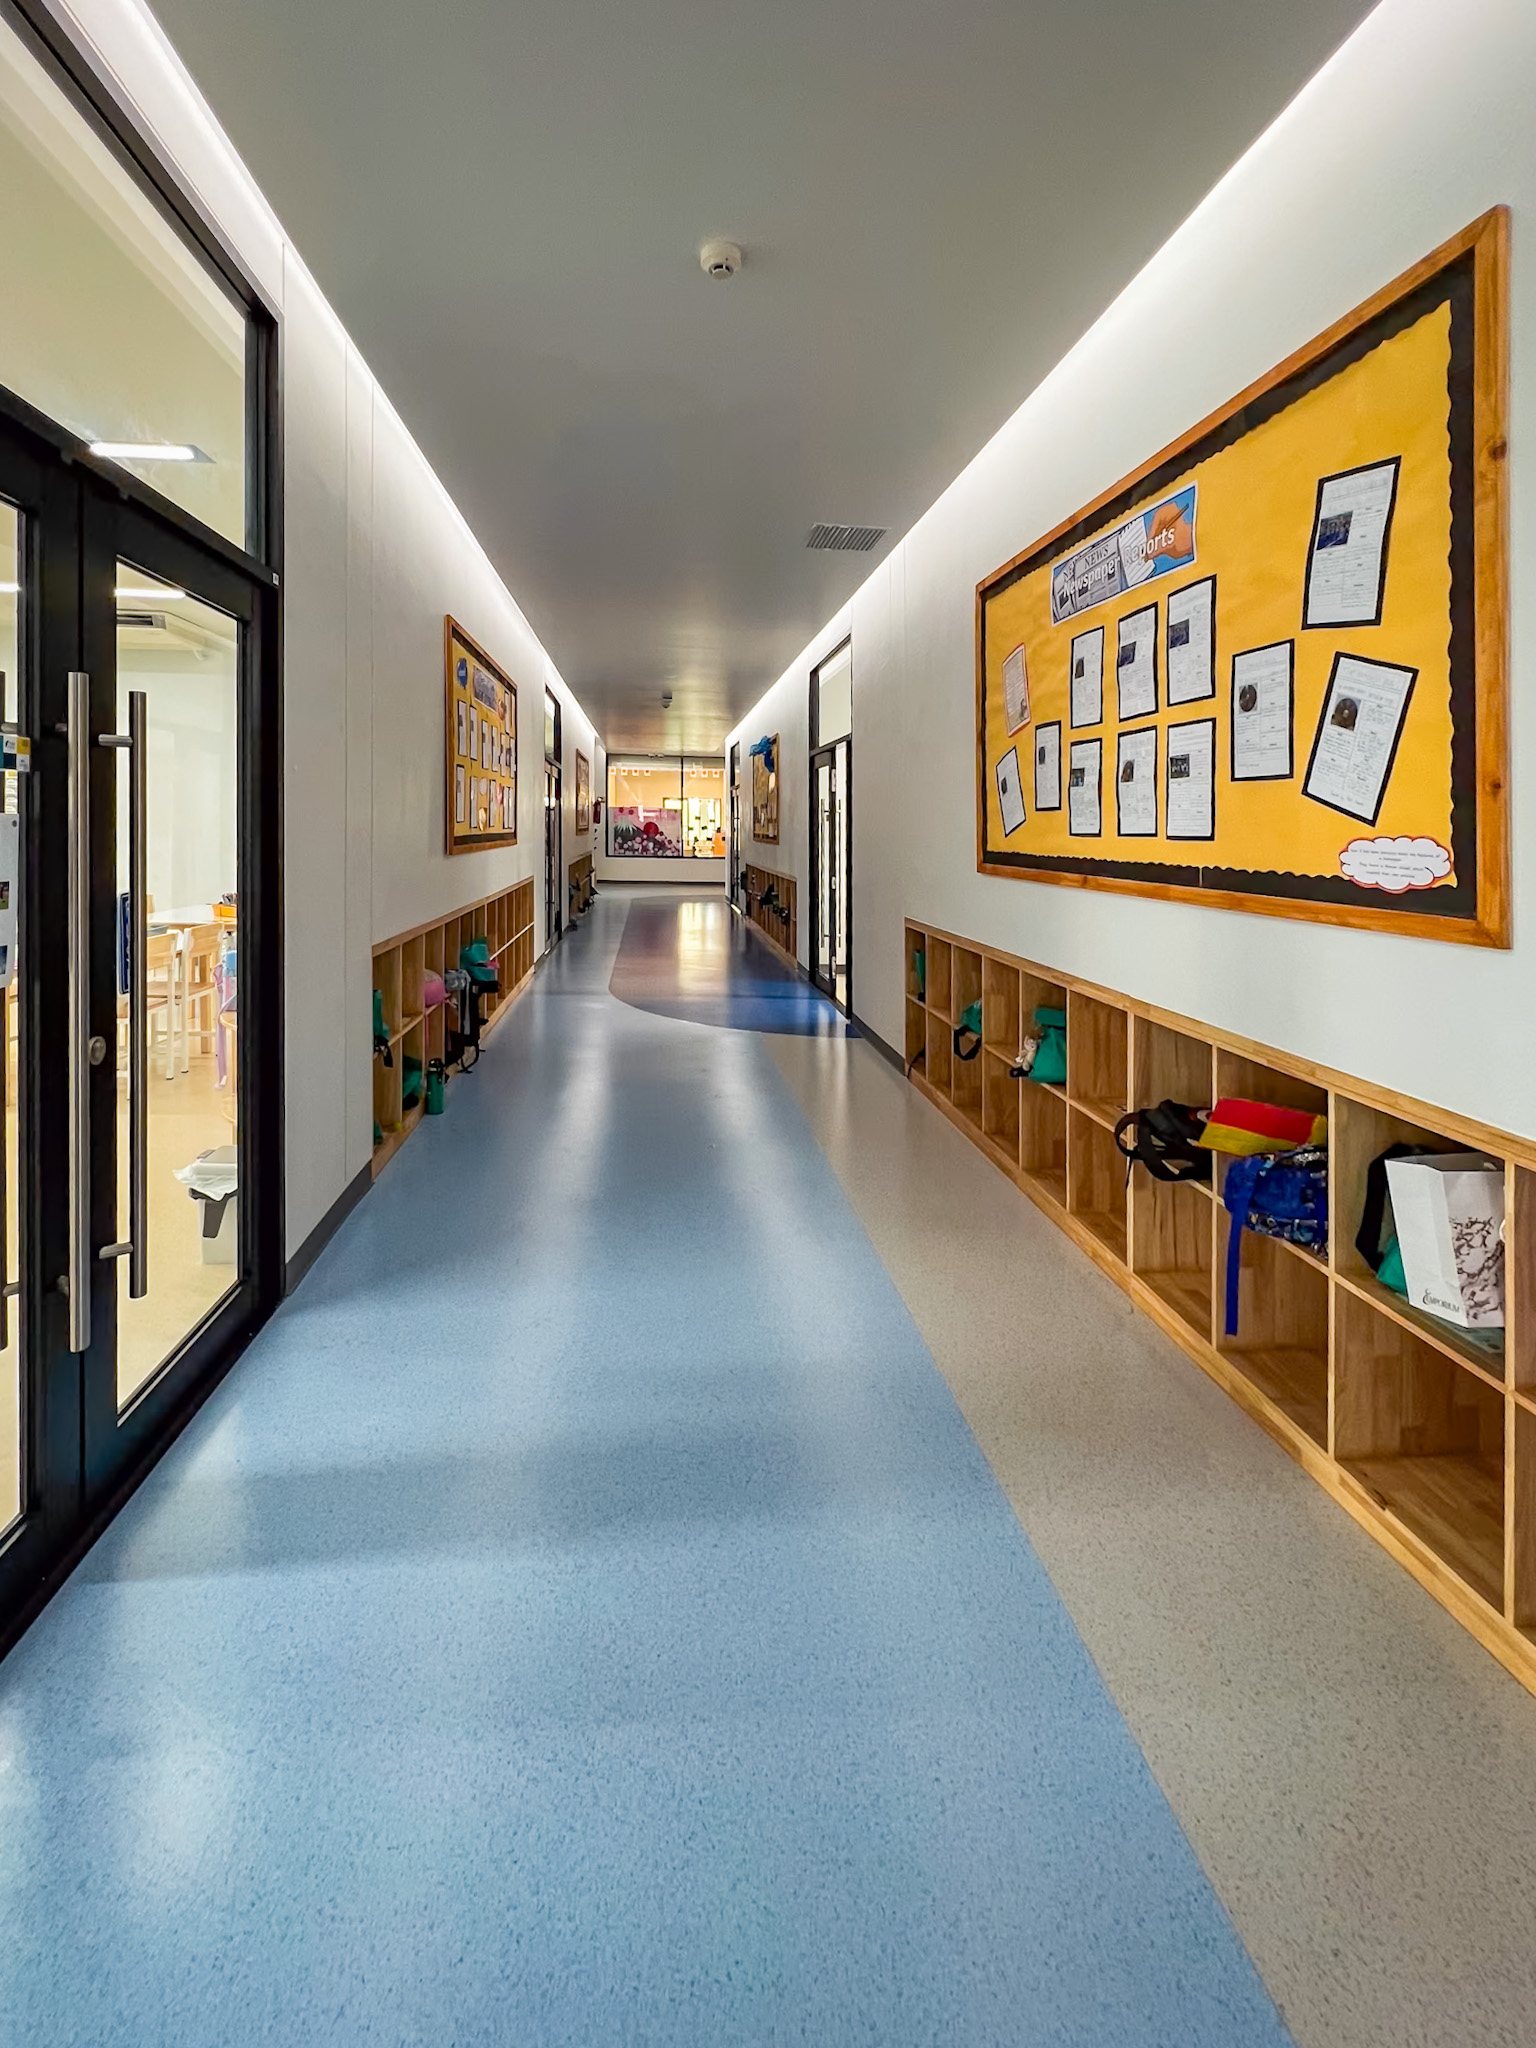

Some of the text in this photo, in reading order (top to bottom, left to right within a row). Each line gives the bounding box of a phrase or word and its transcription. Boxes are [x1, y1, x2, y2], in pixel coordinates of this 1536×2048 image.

[1063, 527, 1174, 597] Newspaper Reports
[1084, 544, 1109, 570] NEWS
